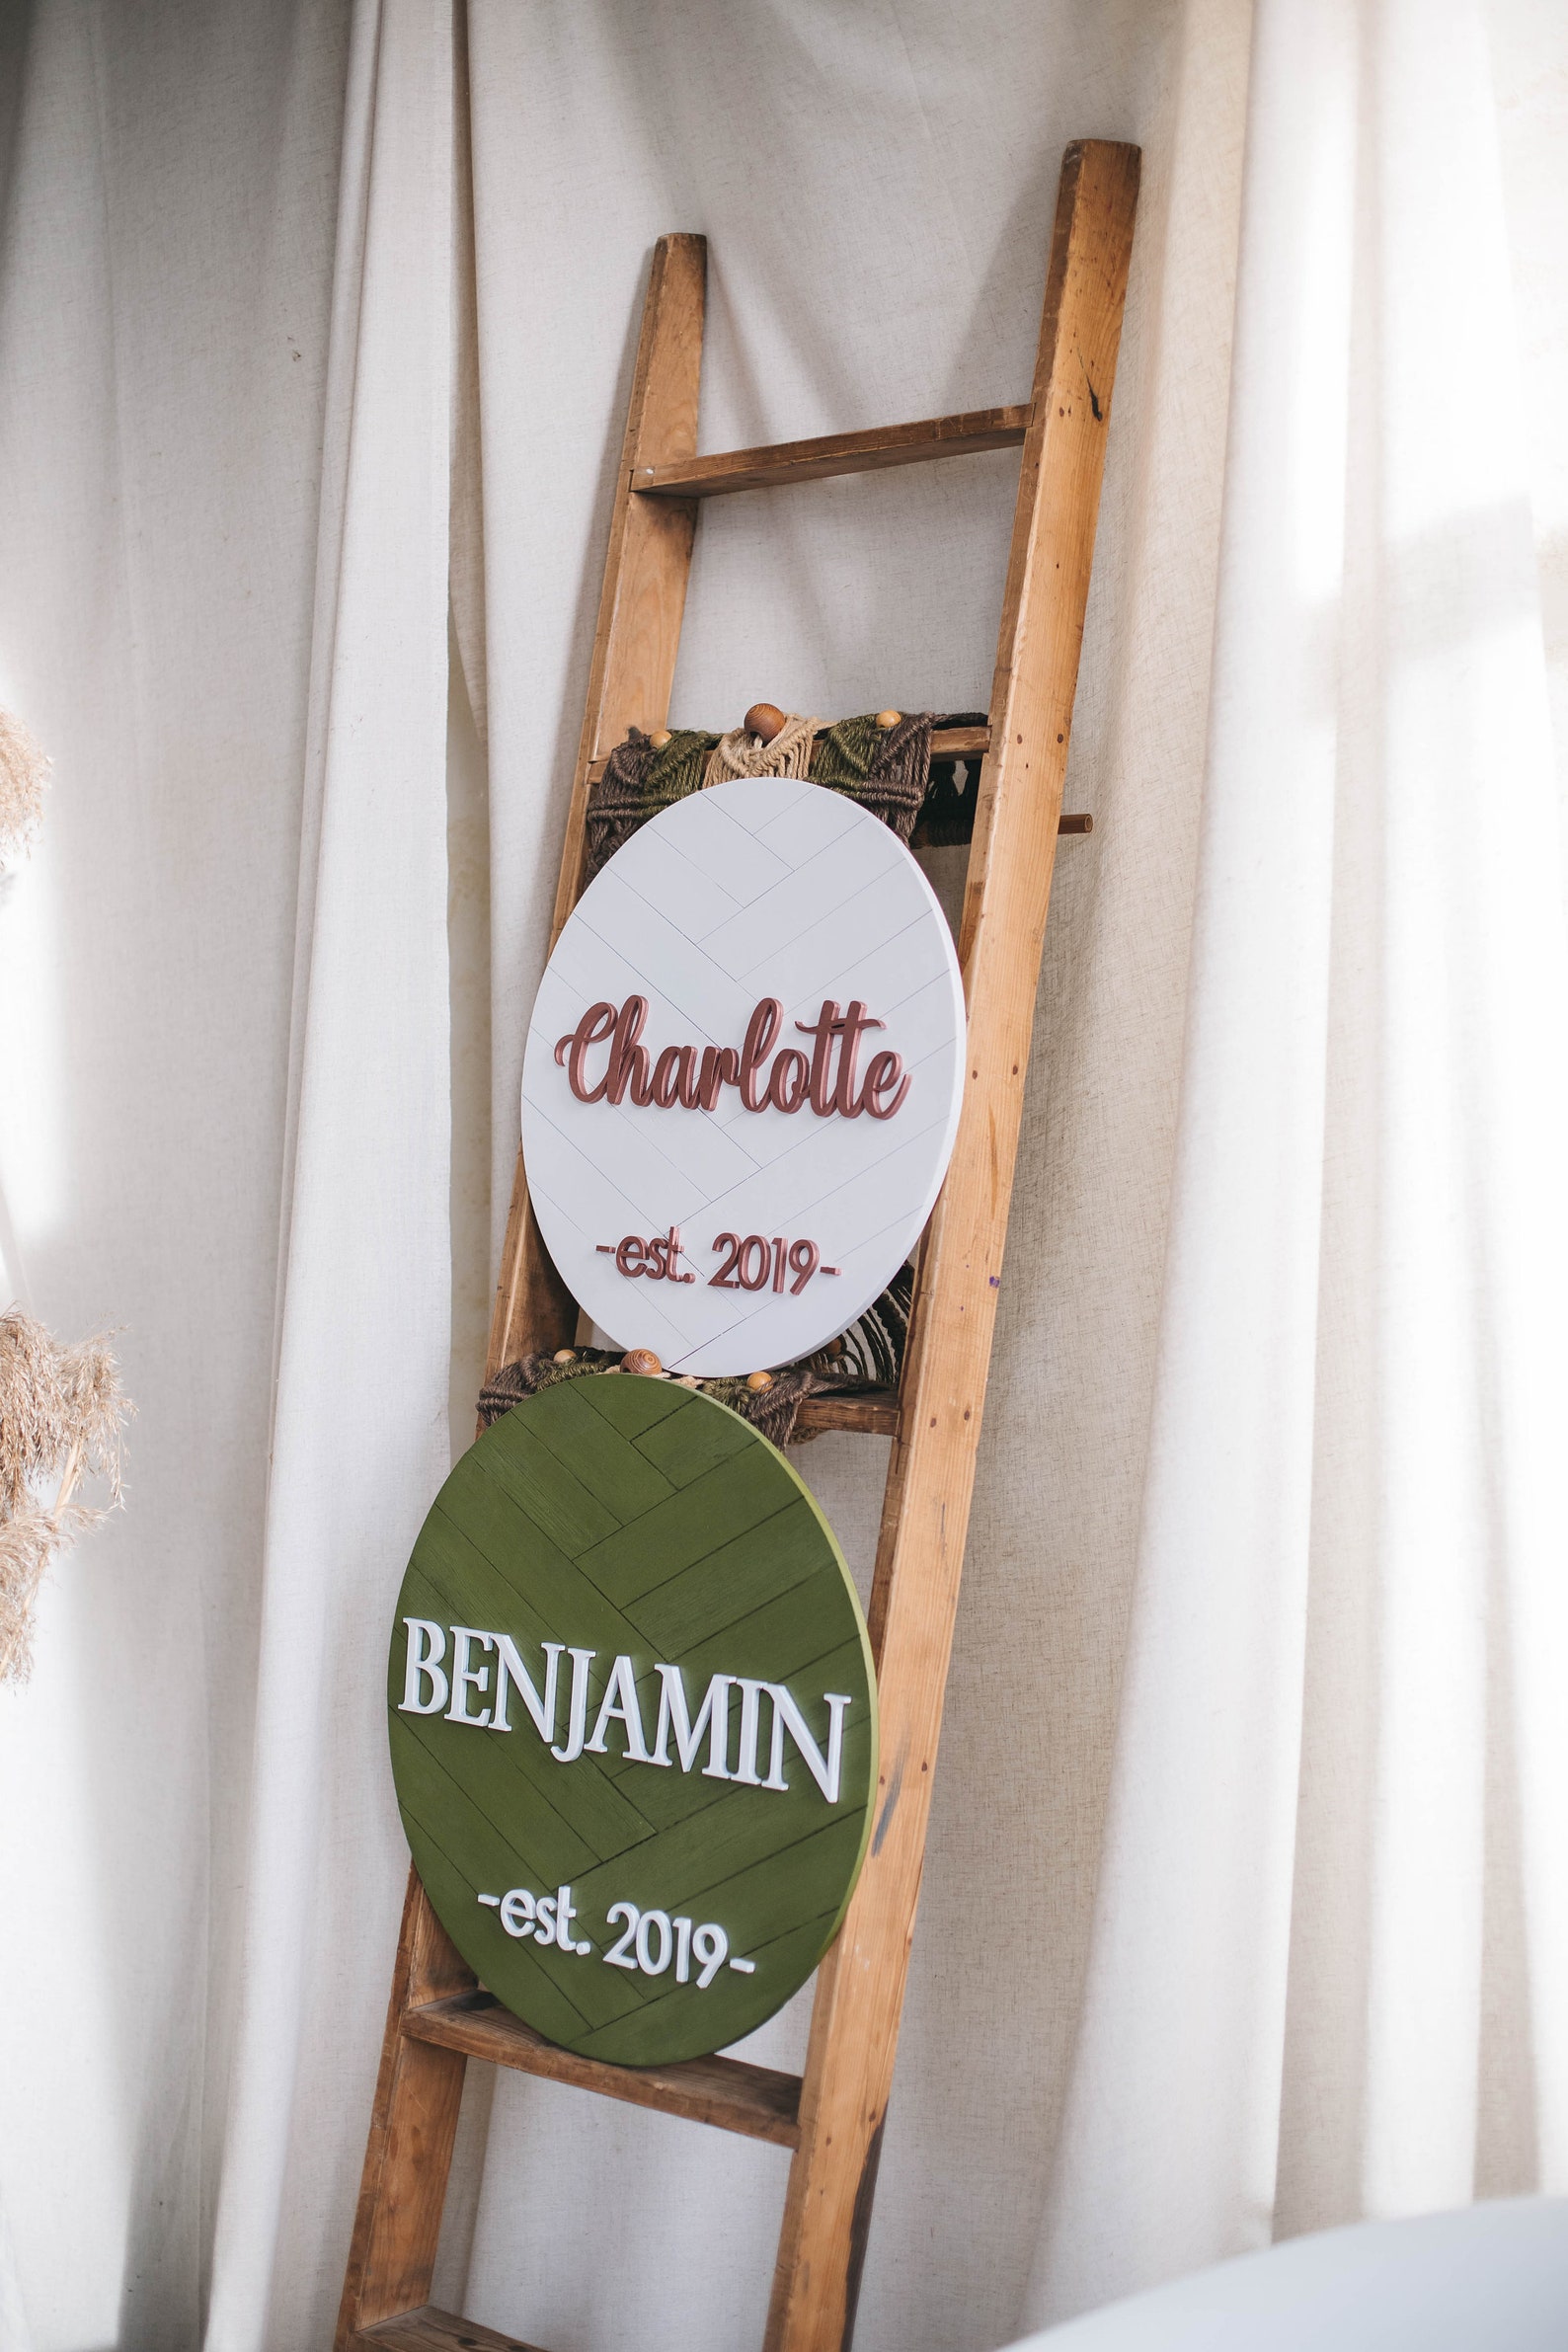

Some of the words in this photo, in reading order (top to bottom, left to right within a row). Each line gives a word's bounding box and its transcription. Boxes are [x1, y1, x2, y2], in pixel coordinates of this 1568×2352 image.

[554, 994, 912, 1120] Charlotte
[595, 1225, 696, 1284] -est.
[707, 1232, 842, 1295] 2019-
[397, 1616, 852, 1804] BENJAMIN
[477, 1885, 590, 1956] -est.
[602, 1902, 756, 1989] 2019-
